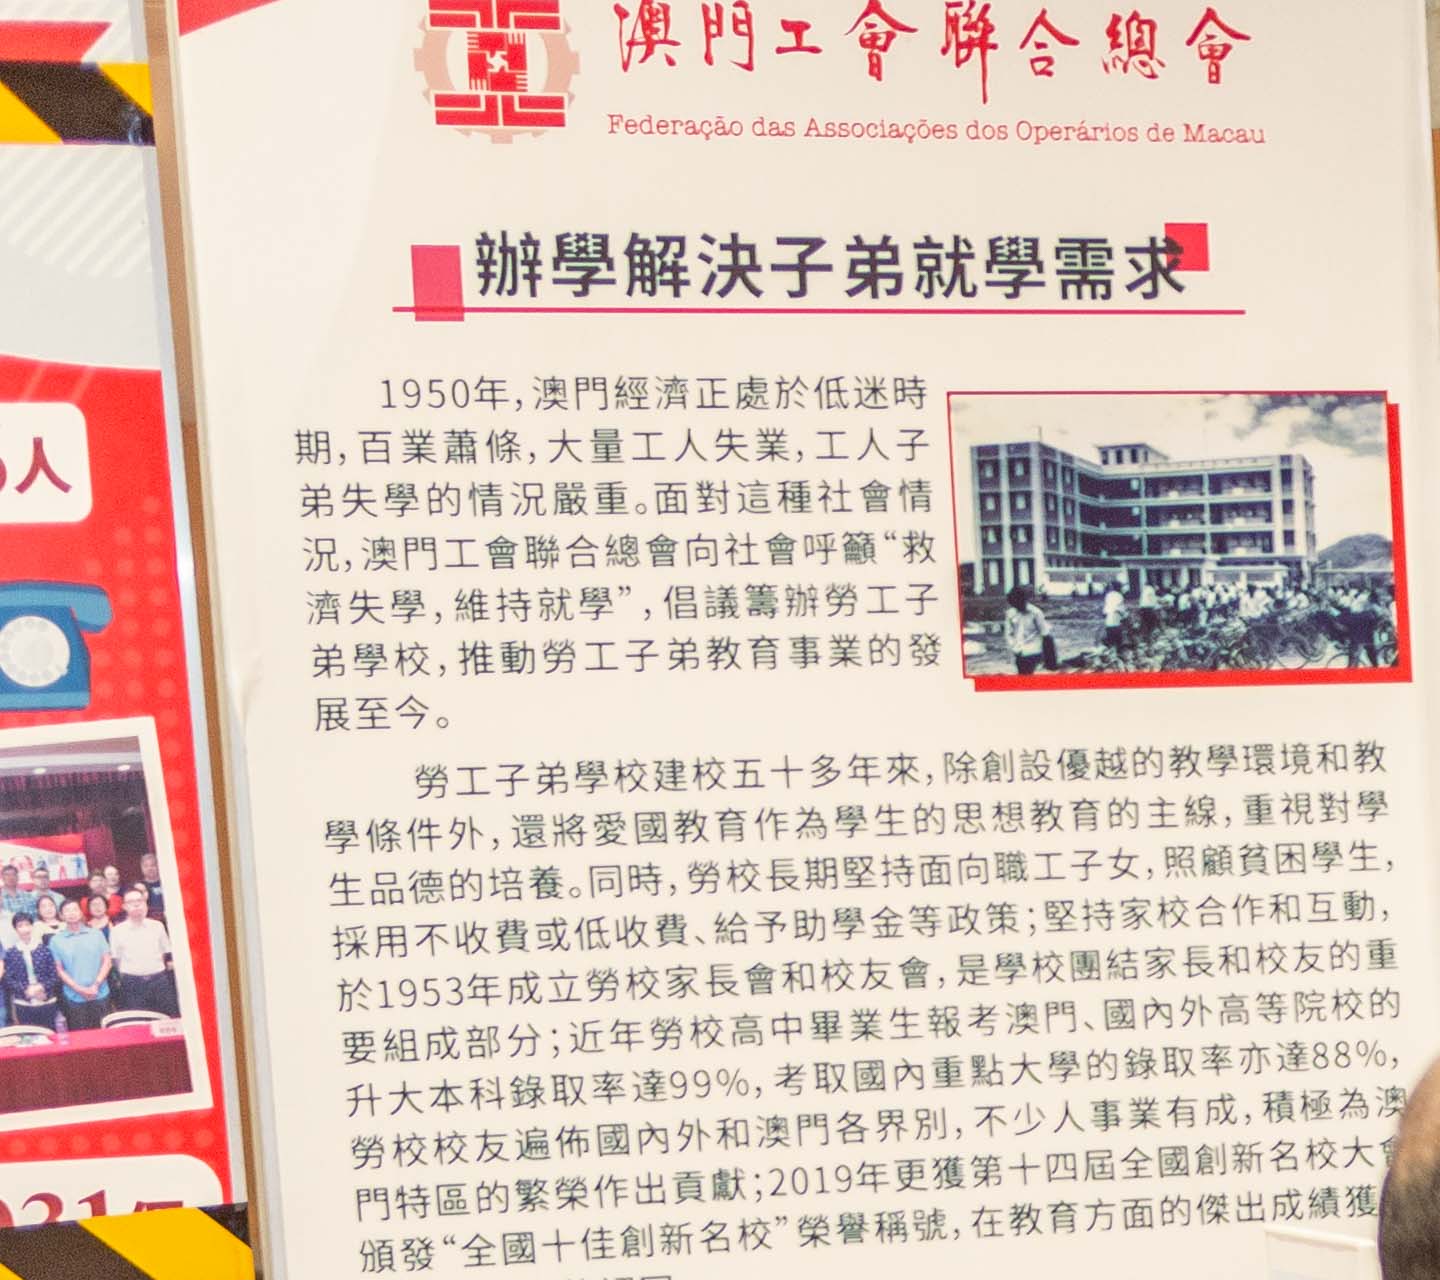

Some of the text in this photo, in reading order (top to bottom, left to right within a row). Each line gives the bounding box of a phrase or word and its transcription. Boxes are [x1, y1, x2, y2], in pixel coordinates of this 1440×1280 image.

[607, 112, 1267, 148] Federação das Associações dos Operários de Macau
[475, 230, 1186, 301] 辦學解決子弟就學需求
[314, 695, 451, 734] 展至今。
